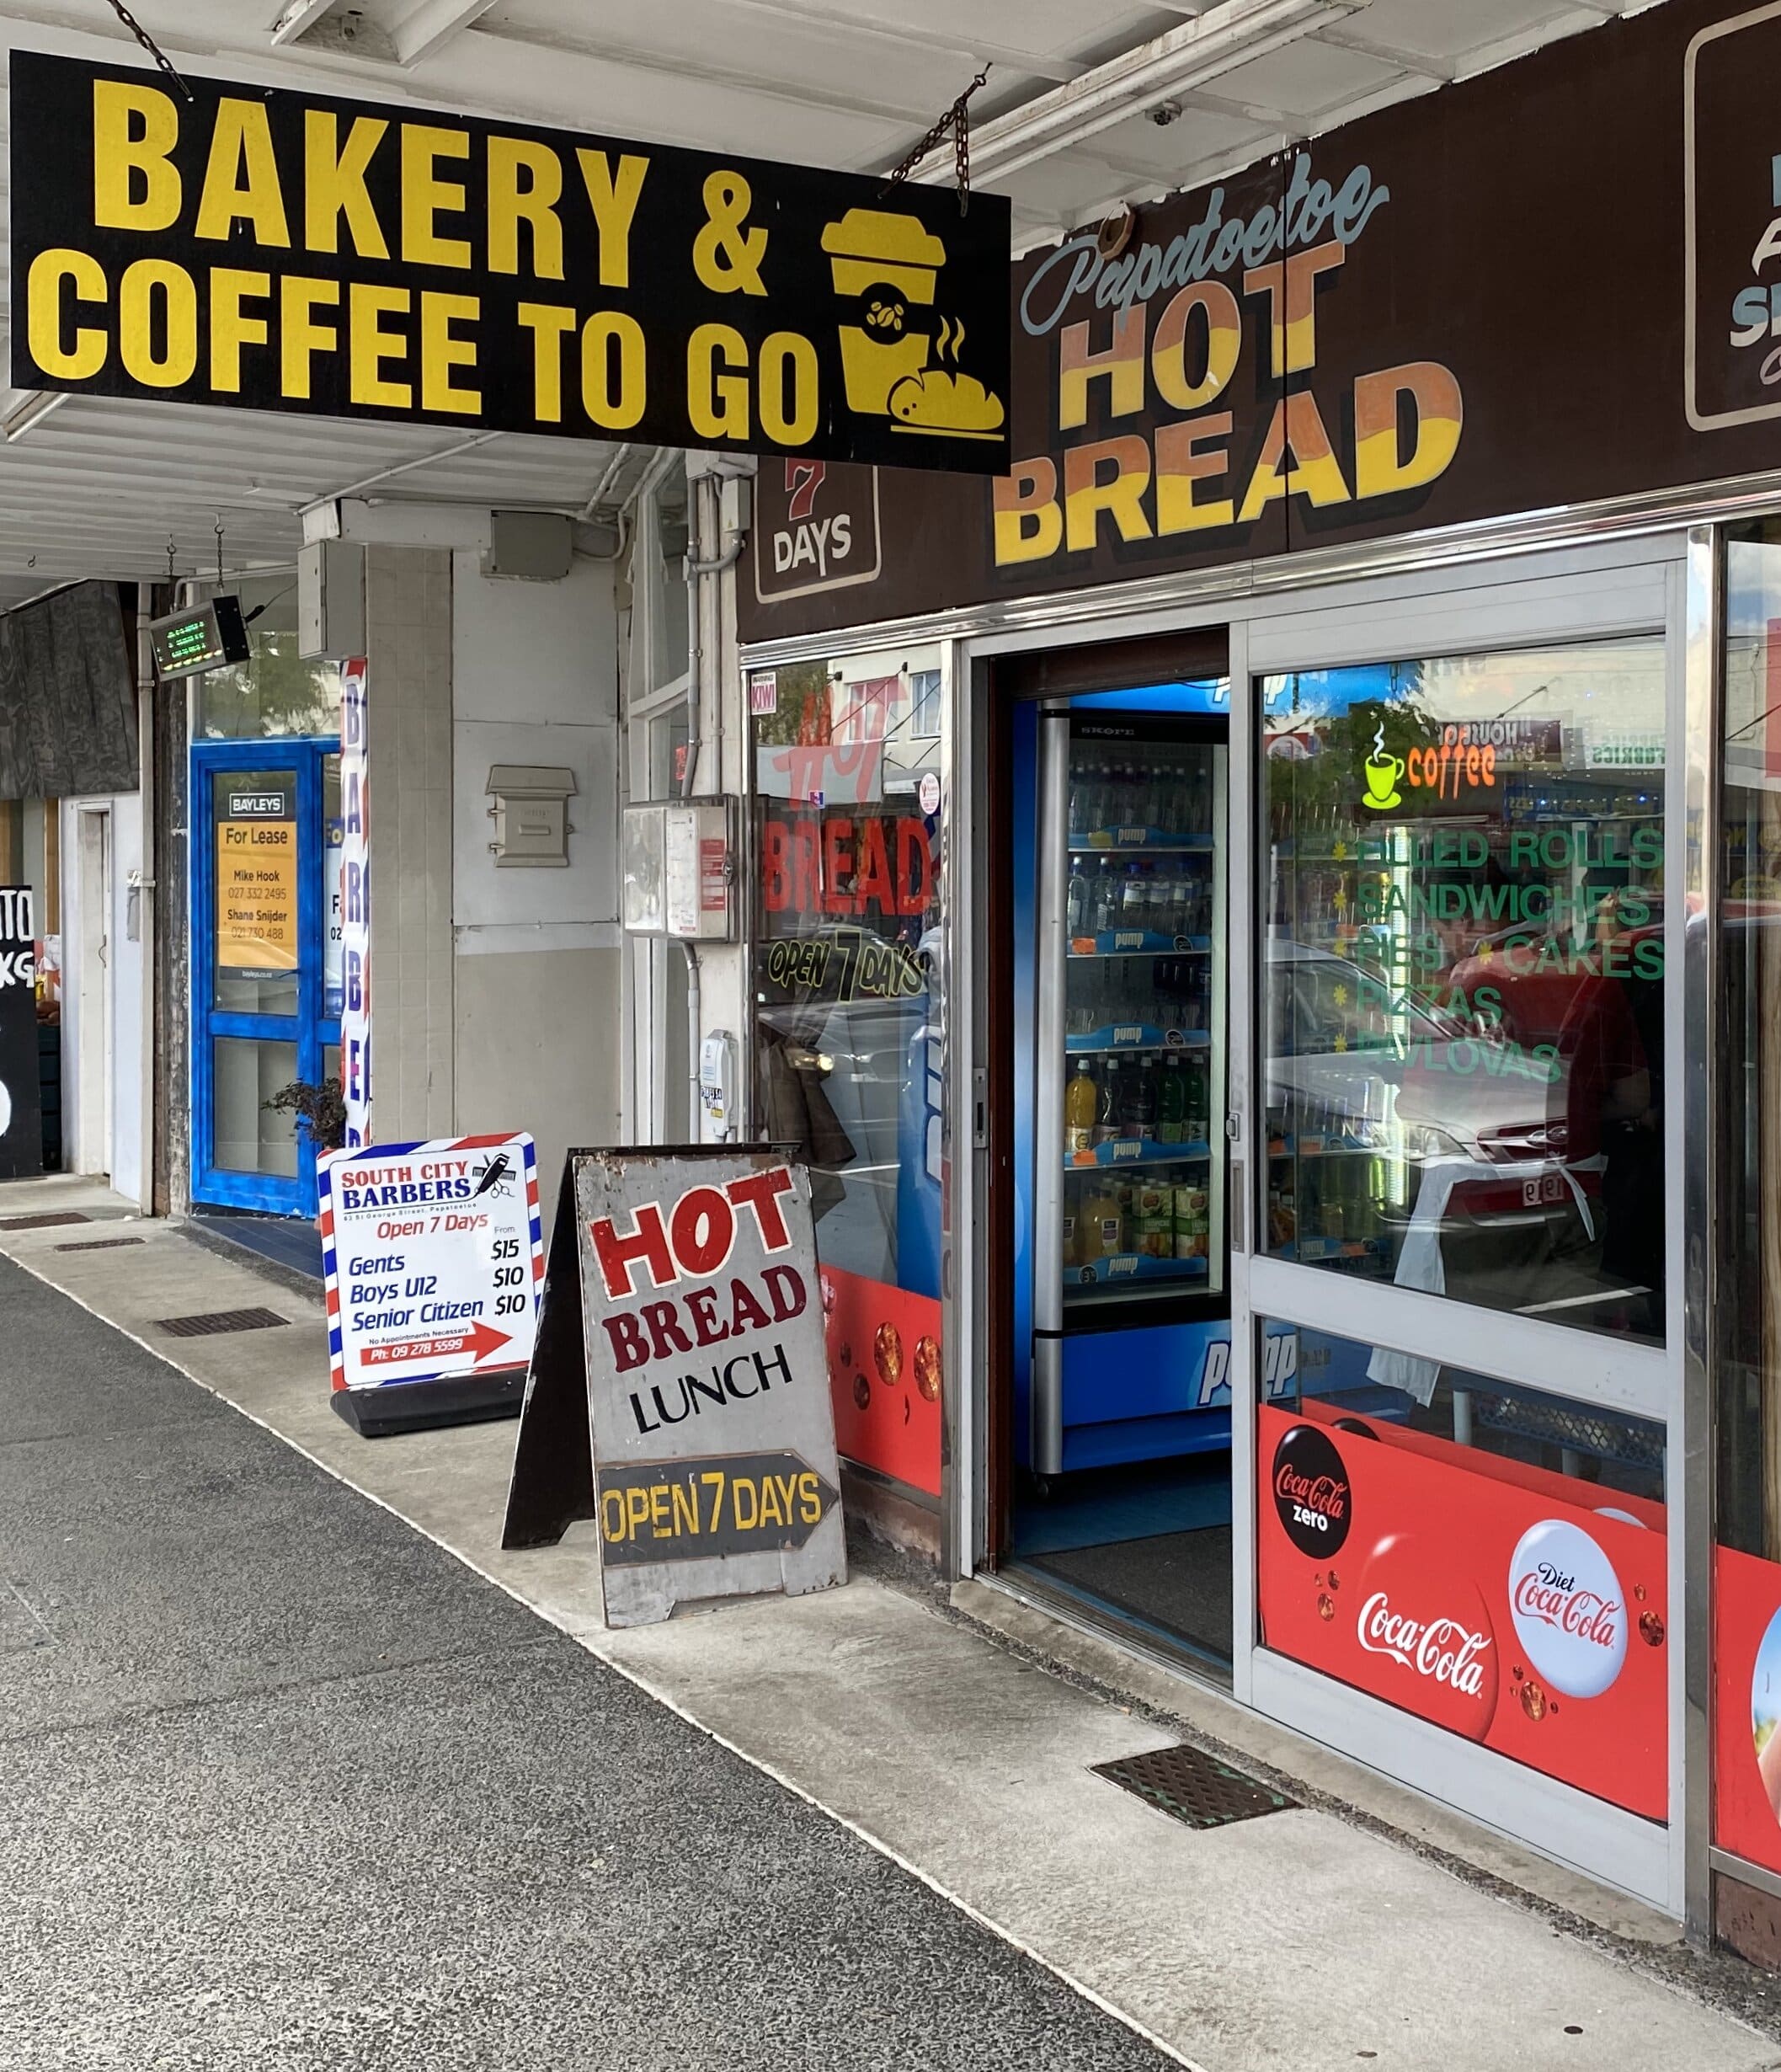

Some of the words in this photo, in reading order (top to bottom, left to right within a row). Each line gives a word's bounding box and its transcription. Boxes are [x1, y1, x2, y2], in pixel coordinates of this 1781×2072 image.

[93, 79, 650, 288] BAKERY
[693, 170, 768, 296] &
[1020, 152, 1390, 335] Papatoetoe
[27, 248, 482, 415] COFFEE
[518, 302, 647, 430] TO
[687, 323, 819, 446] GO
[1059, 241, 1346, 430] HOT
[993, 360, 1464, 567] BREAD
[785, 457, 825, 521] 7
[773, 514, 852, 577] DAYS
[232, 798, 281, 812] BAYLEYS
[226, 827, 248, 844] For
[251, 827, 288, 845] Lease
[1117, 828, 1146, 844] pump
[1357, 830, 1490, 870] FILLED
[1511, 828, 1665, 869] ROLLS
[233, 870, 254, 882] Mike
[256, 870, 280, 882] Hook
[763, 817, 934, 916] BREAD
[228, 888, 245, 900] 027
[247, 888, 263, 900] 332
[264, 888, 287, 900] 2495
[1357, 883, 1651, 926] SANDWICHES
[227, 909, 254, 921] Shane
[256, 910, 287, 922] Snijder
[345, 681, 363, 1145] BARBE
[266, 927, 284, 940] 488
[1115, 932, 1144, 949] pump
[768, 940, 832, 989] OPEN
[835, 927, 862, 1003] 7
[859, 945, 926, 997] DAYS
[1357, 932, 1442, 971] PIES
[1503, 934, 1665, 980] CAKES
[1113, 1027, 1142, 1044] pump
[1113, 1142, 1141, 1160] pump
[341, 1166, 411, 1188] SOUTH
[421, 1161, 468, 1179] CITY
[343, 1178, 471, 1210] BARBERS
[377, 1220, 424, 1241] Open
[429, 1216, 440, 1233] 7
[445, 1214, 488, 1232] Days
[494, 1226, 515, 1235] From
[589, 1164, 797, 1302] HOT
[349, 1254, 405, 1277] Gents
[491, 1239, 520, 1262] $15
[492, 1266, 524, 1289] $10
[1109, 1258, 1138, 1275] pump
[349, 1283, 399, 1305] Boys
[405, 1275, 437, 1298] U12
[494, 1294, 526, 1316] $10
[351, 1309, 414, 1332] Senior
[421, 1300, 483, 1323] Citizen
[602, 1264, 807, 1375] BREAD
[371, 1348, 389, 1362] Ph:
[392, 1347, 408, 1359] 09
[410, 1344, 432, 1356] 278
[434, 1338, 463, 1354] 5599
[381, 1332, 430, 1345] Appointments
[432, 1327, 469, 1337] Necessary
[630, 1343, 792, 1434] LUNCH
[1276, 1463, 1347, 1519] Coca-Cola
[601, 1478, 700, 1544] OPEN
[701, 1471, 725, 1533] 7
[733, 1471, 822, 1531] DAYS
[1293, 1504, 1328, 1532] zero
[1538, 1562, 1575, 1593] Diet
[1515, 1572, 1622, 1648] Coca-Cola
[1357, 1591, 1491, 1696] Coca-Cola
